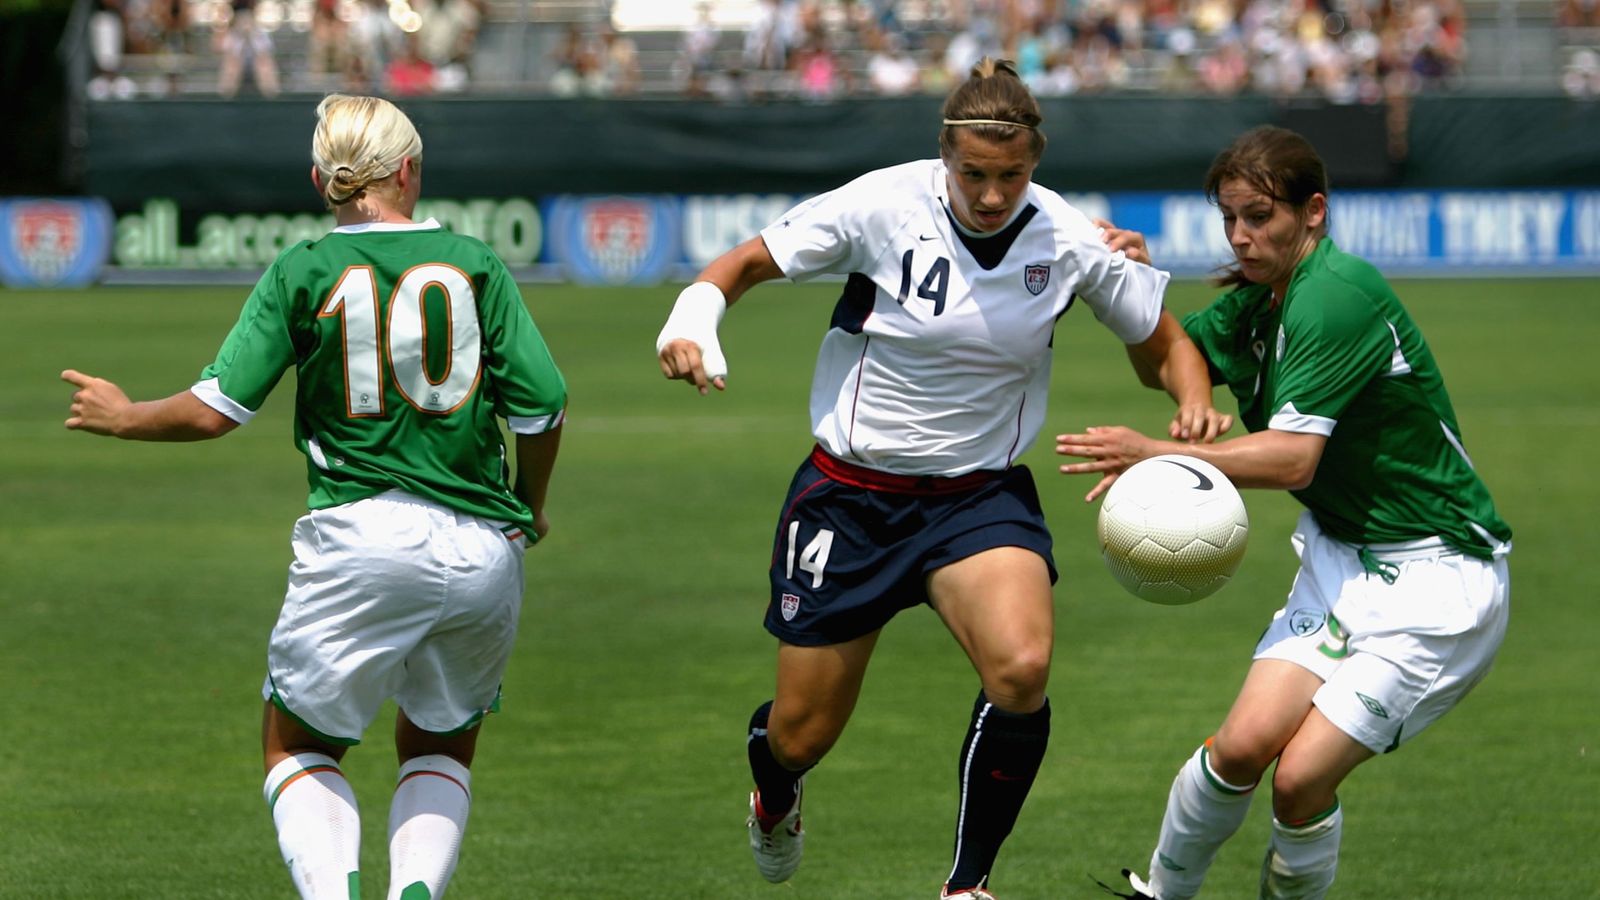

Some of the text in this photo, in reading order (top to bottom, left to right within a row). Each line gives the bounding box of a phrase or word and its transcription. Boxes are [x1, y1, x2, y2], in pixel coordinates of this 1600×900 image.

[897, 249, 950, 316] 14
[317, 262, 482, 418] 10
[786, 520, 834, 588] 14
